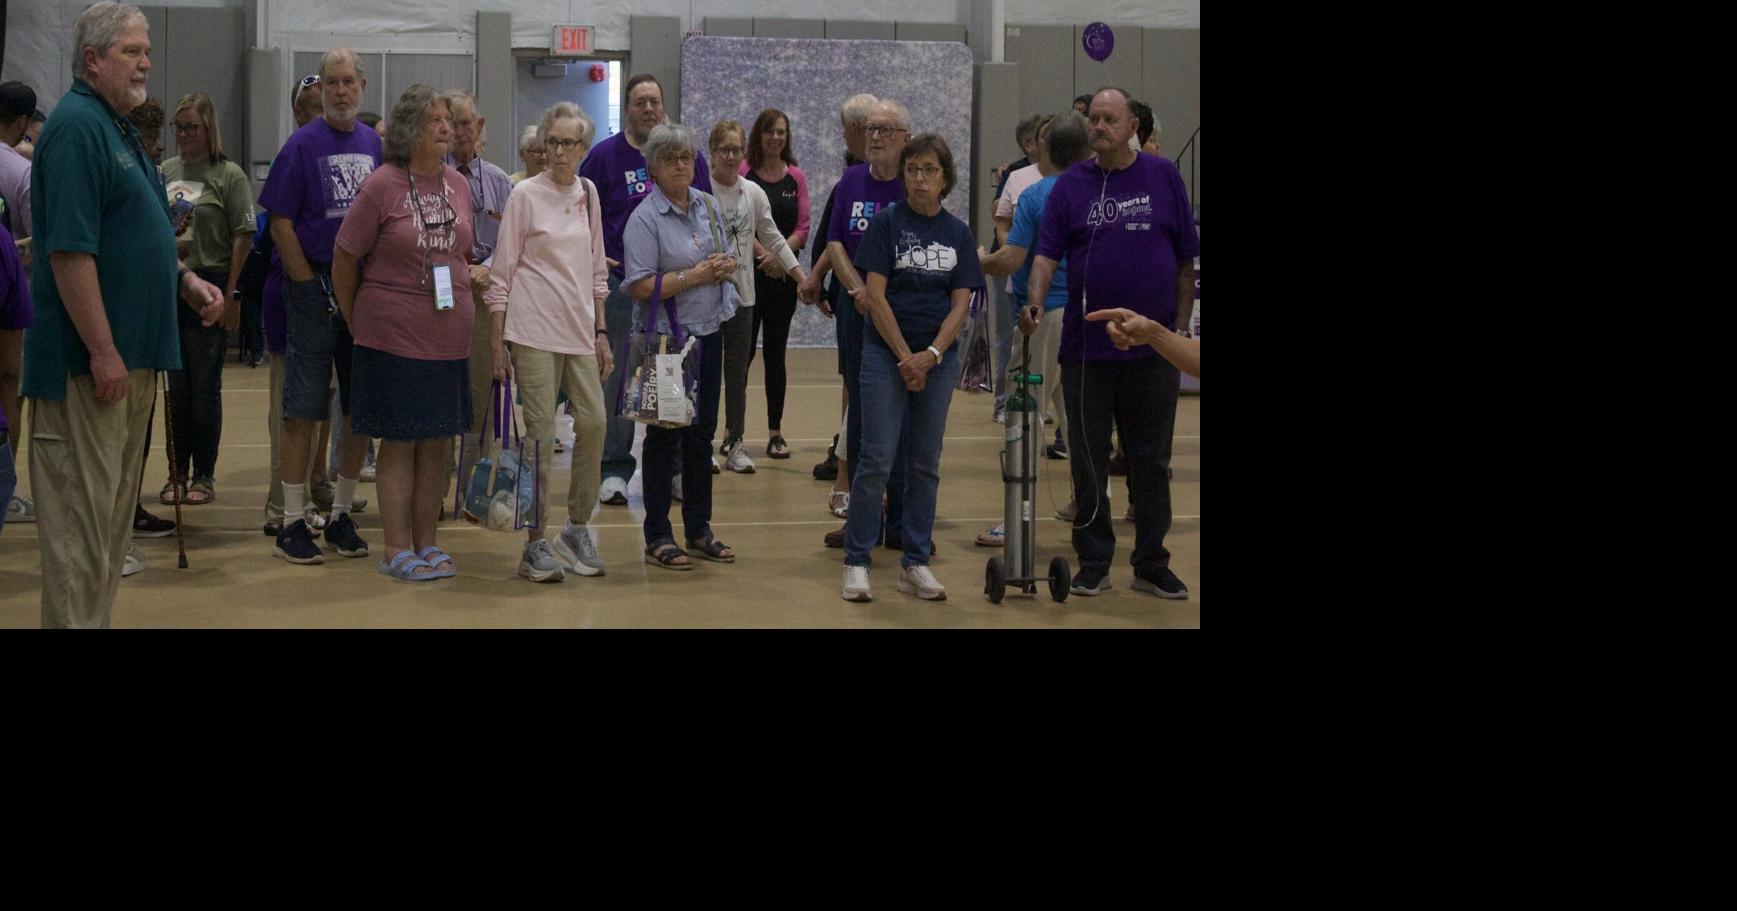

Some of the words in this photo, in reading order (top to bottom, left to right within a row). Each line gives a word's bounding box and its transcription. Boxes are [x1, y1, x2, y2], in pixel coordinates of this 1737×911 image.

[561, 28, 588, 50] EXIT
[625, 168, 648, 185] RE
[851, 201, 897, 218] REL
[1087, 198, 1119, 226] 40
[1117, 197, 1140, 212] years
[1141, 195, 1150, 204] of
[849, 218, 869, 231] FO
[417, 231, 458, 252] Kind
[896, 245, 951, 270] HOPE
